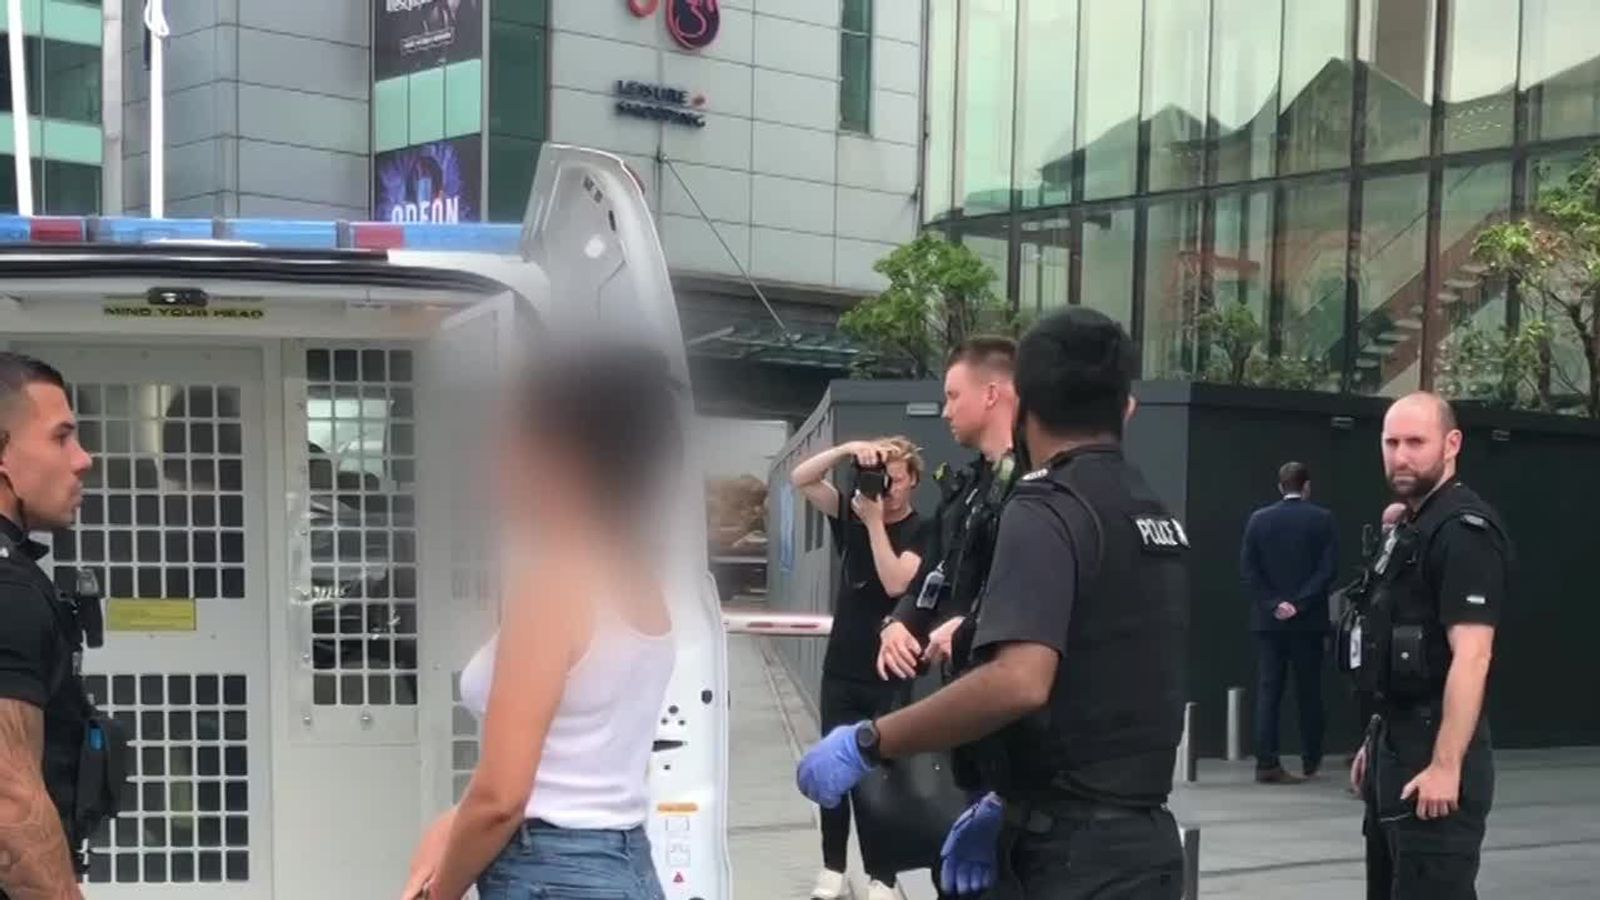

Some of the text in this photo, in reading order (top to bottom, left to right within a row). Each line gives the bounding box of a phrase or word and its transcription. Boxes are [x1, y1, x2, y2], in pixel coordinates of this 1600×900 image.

[615, 79, 688, 104] LEISURE
[391, 196, 459, 224] ODEON
[103, 306, 264, 320] MIND YOUR HEAD
[1135, 518, 1178, 545] POLICE
